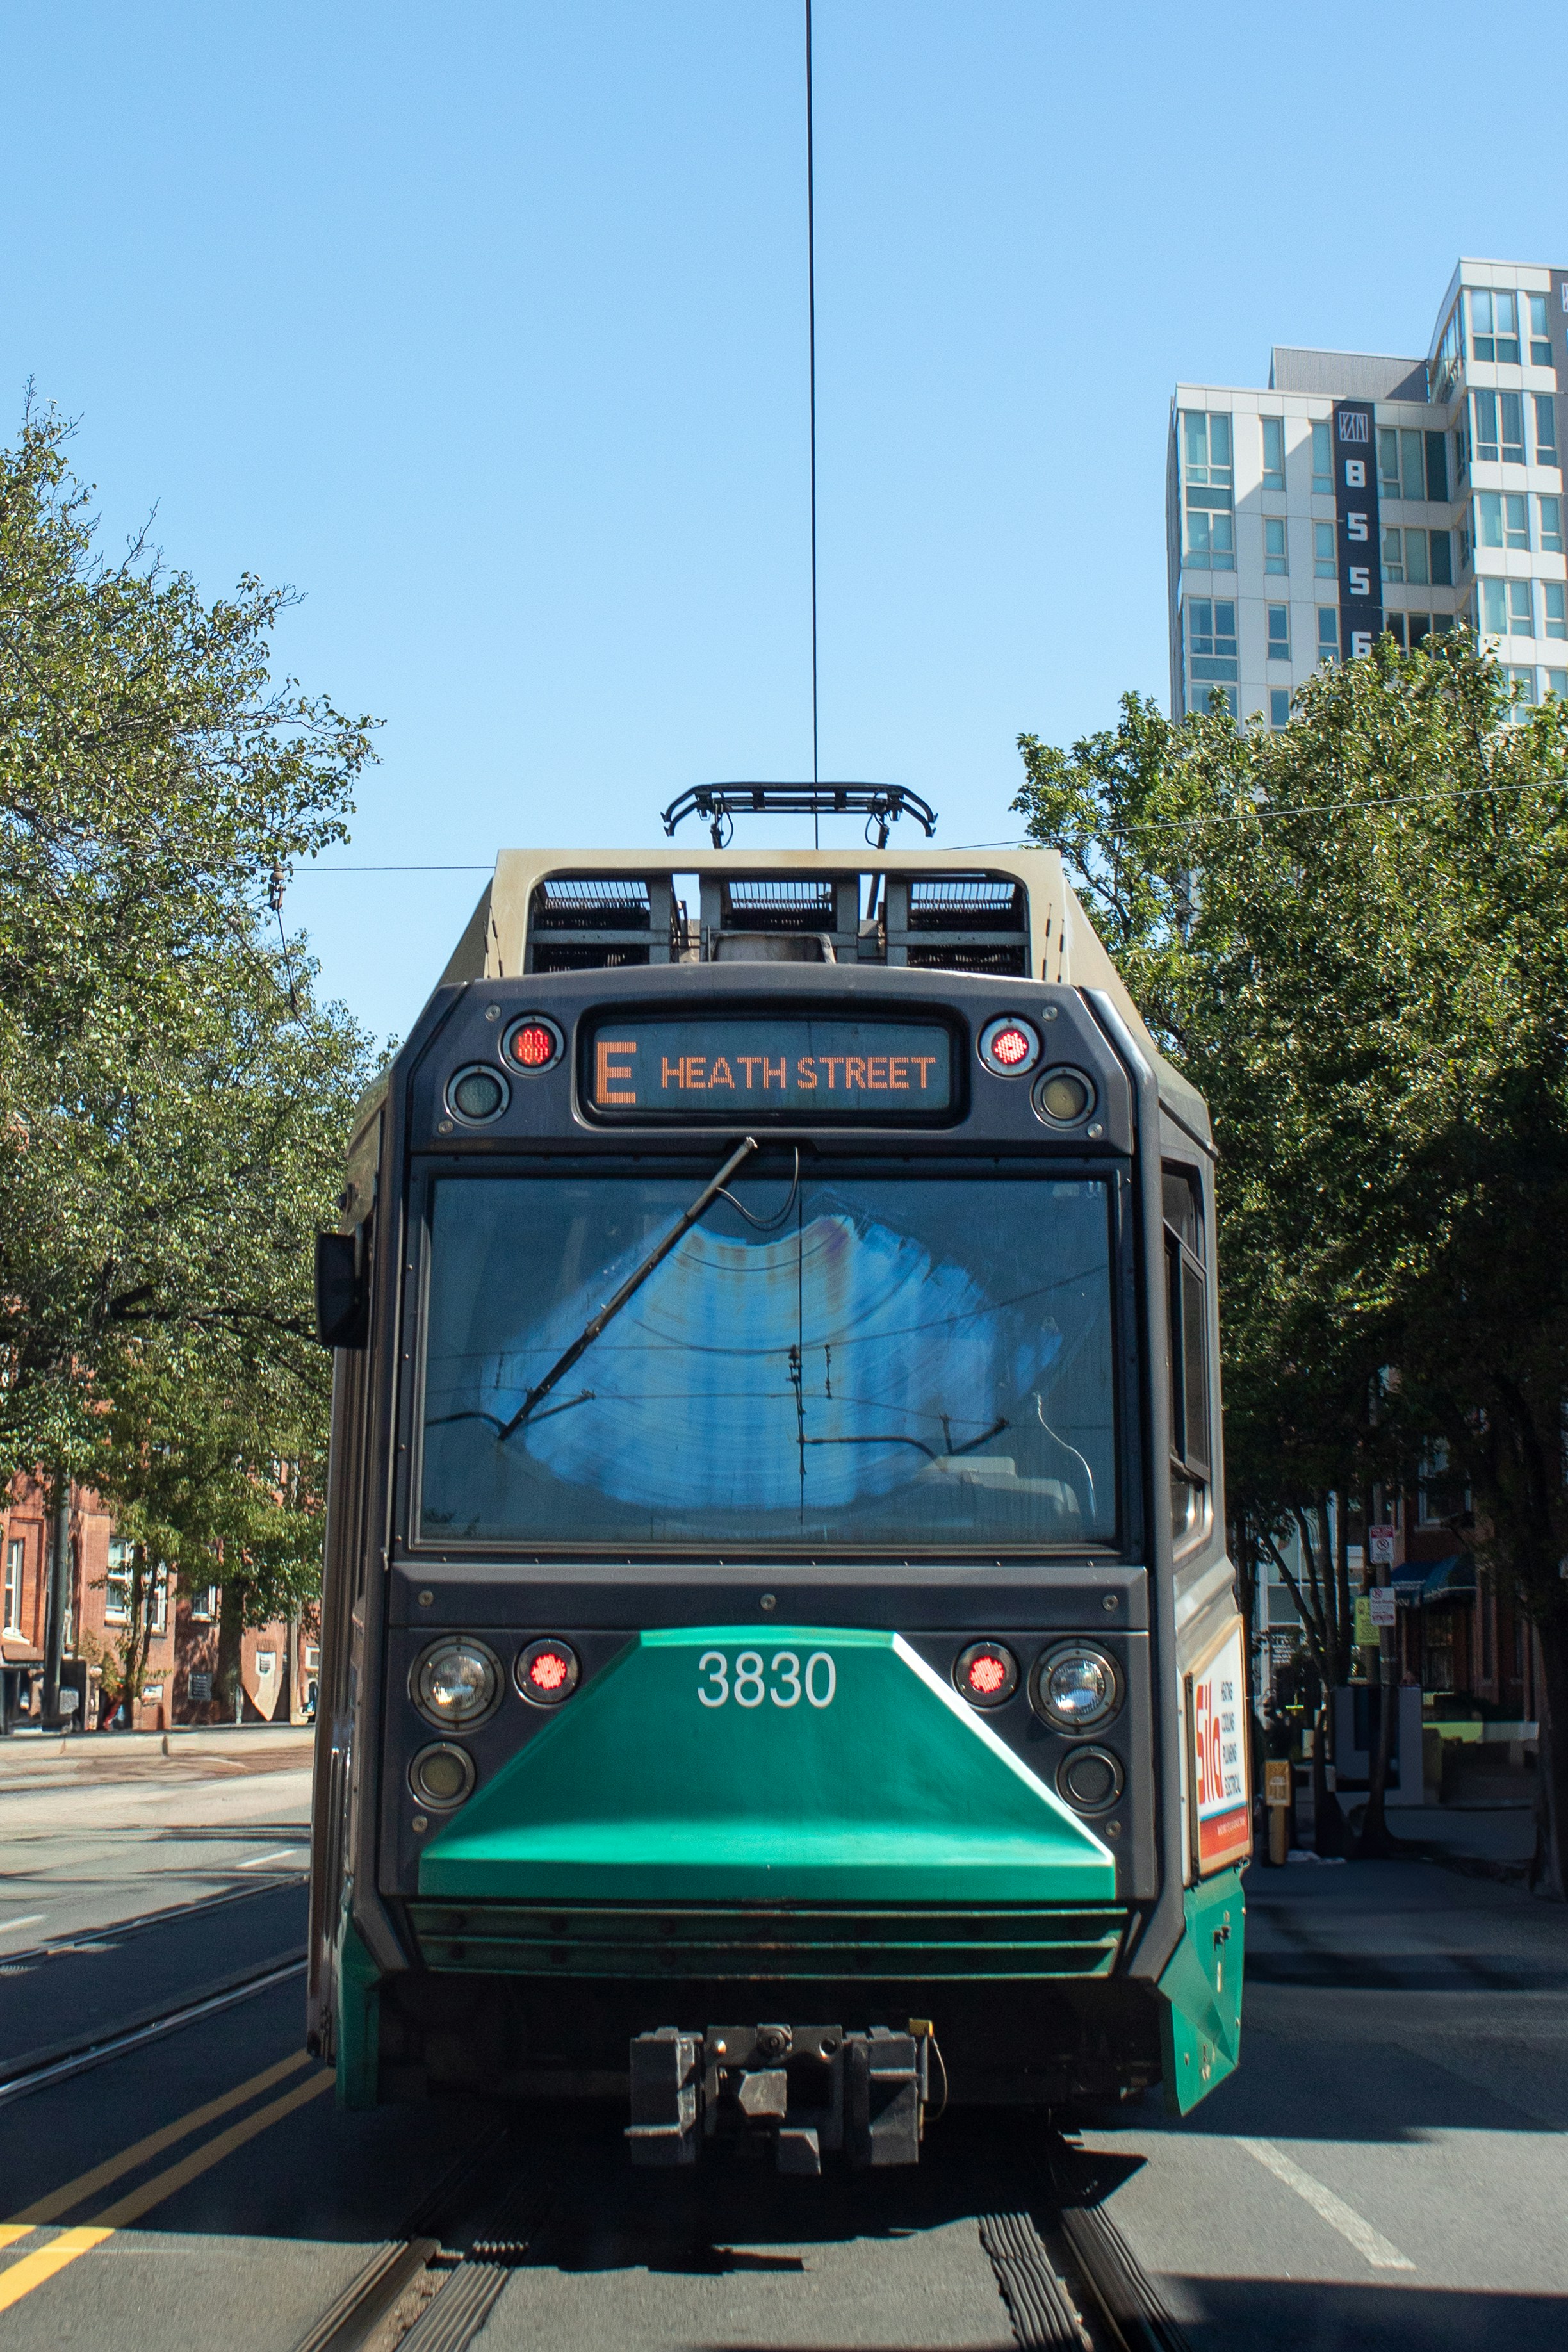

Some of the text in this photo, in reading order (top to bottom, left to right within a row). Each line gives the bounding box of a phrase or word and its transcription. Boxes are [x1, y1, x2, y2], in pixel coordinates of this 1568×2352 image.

[596, 1042, 936, 1104] E HEATH STREET
[698, 1651, 836, 1708] 3830
